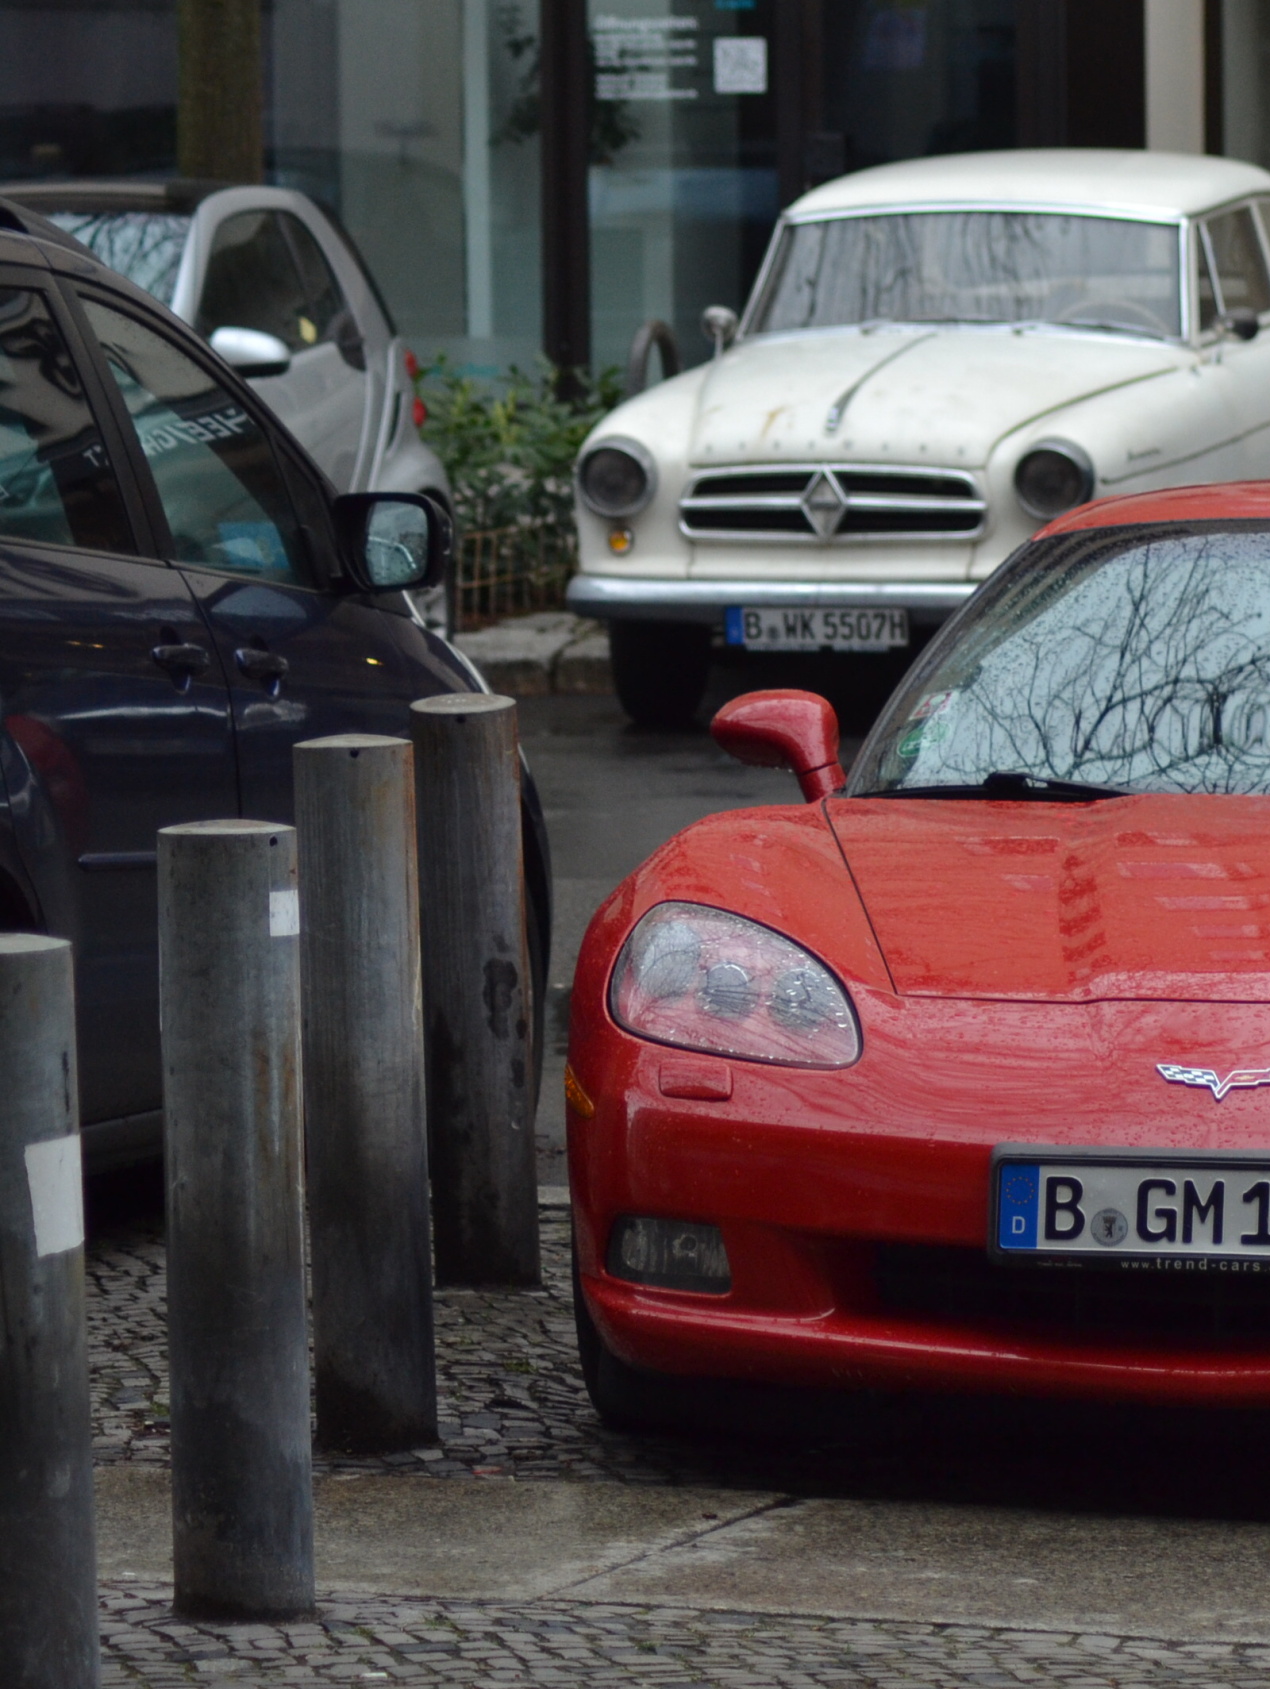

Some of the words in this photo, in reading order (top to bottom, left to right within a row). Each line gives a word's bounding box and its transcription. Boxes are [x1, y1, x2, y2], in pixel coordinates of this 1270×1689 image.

[746, 613, 762, 640] B
[783, 613, 815, 640] WK
[823, 613, 906, 641] 5507H
[1044, 1176, 1086, 1241] B
[1136, 1178, 1225, 1245] GM
[1011, 1216, 1026, 1234] D
